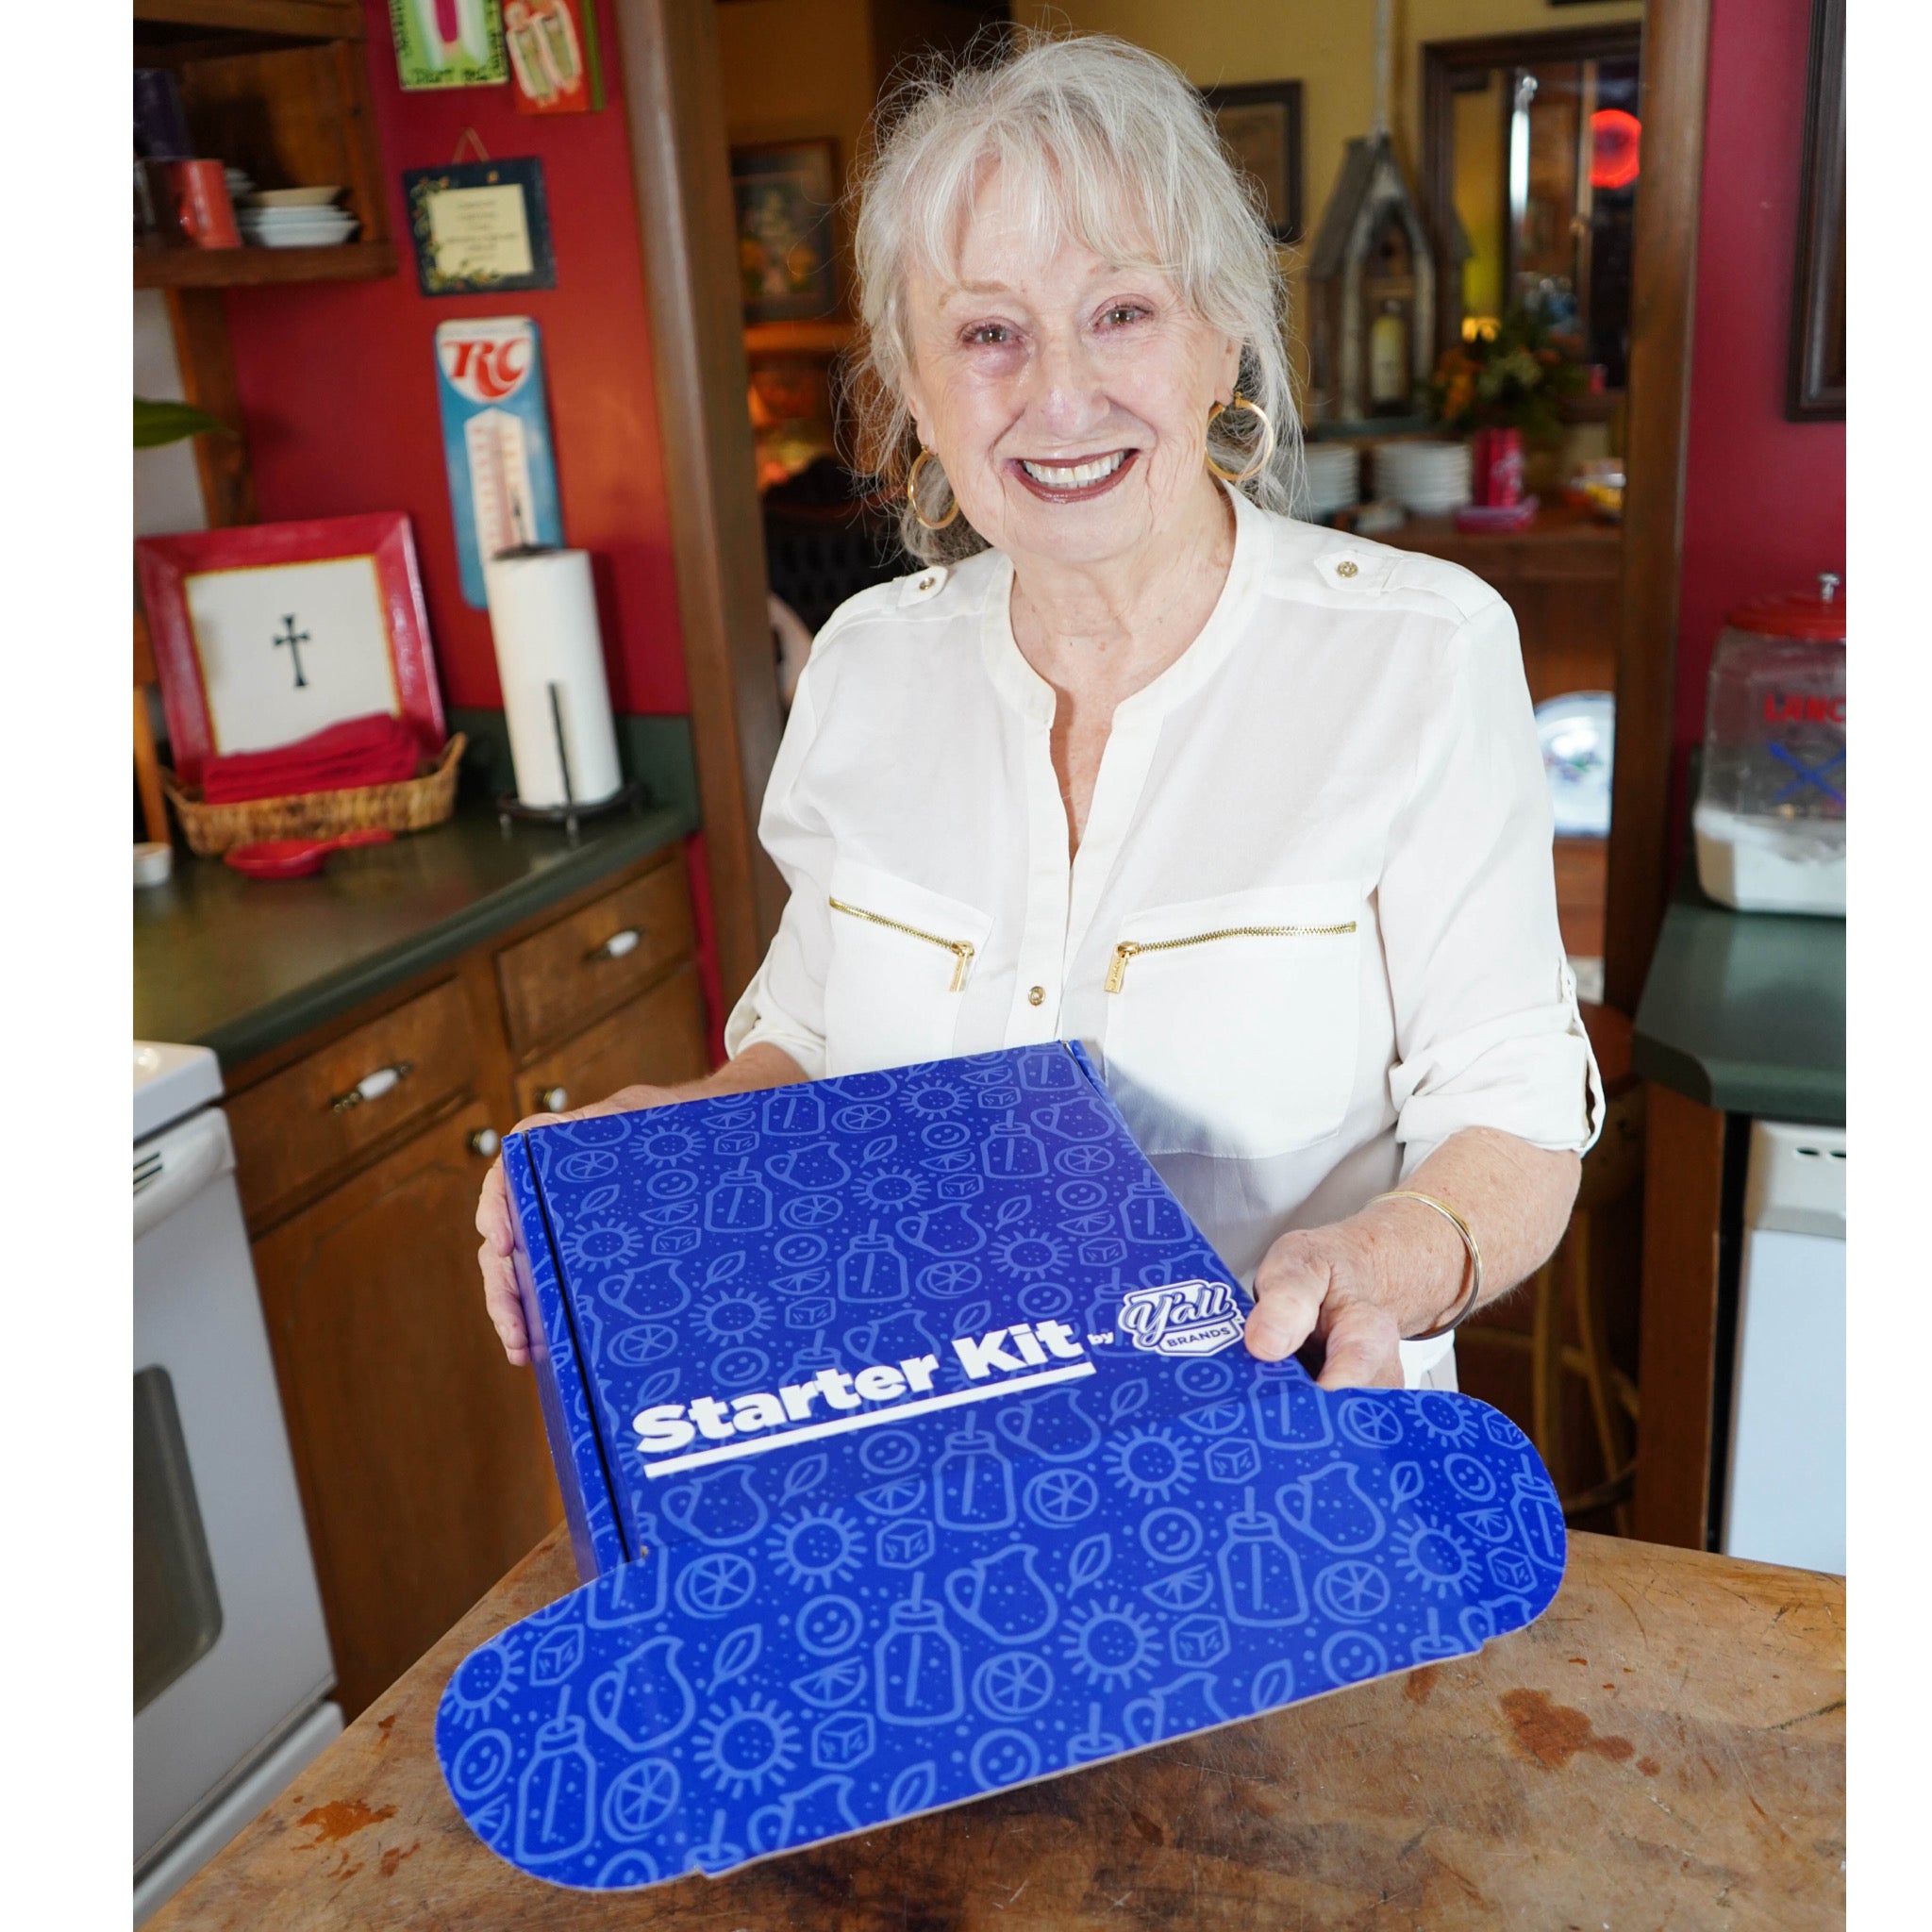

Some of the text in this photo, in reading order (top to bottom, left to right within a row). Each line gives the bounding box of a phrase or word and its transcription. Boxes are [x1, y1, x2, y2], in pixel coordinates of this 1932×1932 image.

[441, 338, 528, 398] RC
[1122, 1286, 1237, 1348] Y'all
[1166, 1327, 1231, 1347] BRANDS
[632, 1320, 1114, 1453] Starter Kit by
